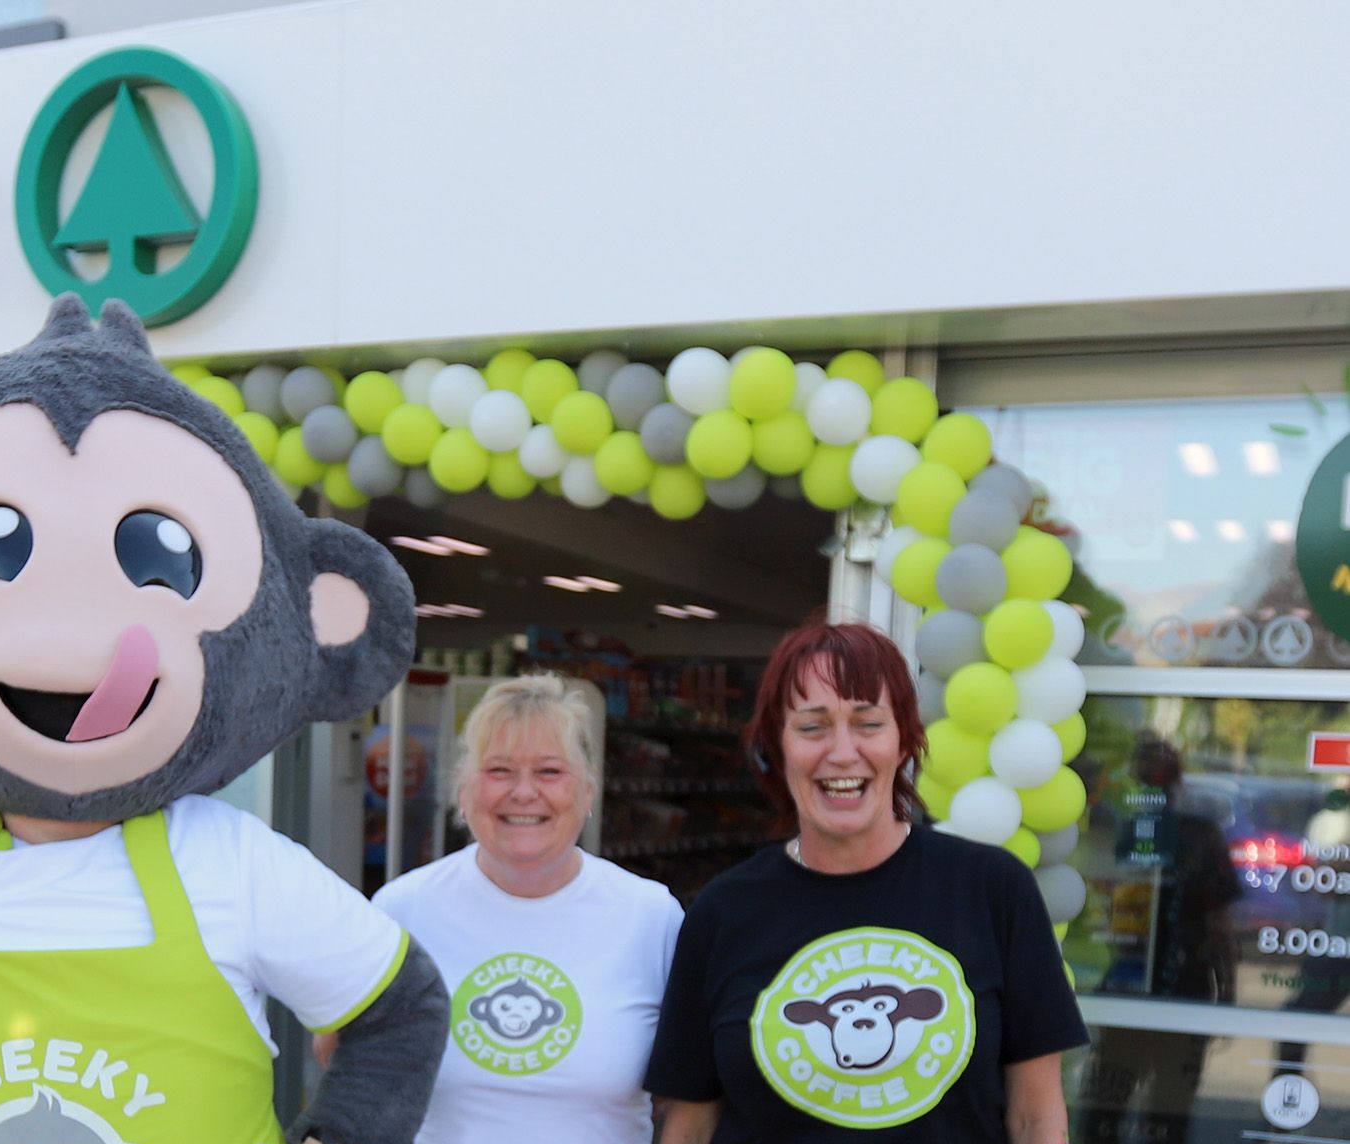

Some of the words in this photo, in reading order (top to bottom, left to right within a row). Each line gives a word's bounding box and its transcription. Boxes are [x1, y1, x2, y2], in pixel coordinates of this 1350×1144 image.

[1125, 794, 1168, 805] HIRING
[1257, 926, 1350, 958] 8.00a
[473, 956, 567, 989] CHEEKY
[792, 942, 940, 994] CHEEKY
[456, 1020, 542, 1071] COFFEE
[776, 1037, 910, 1109] COFFEE
